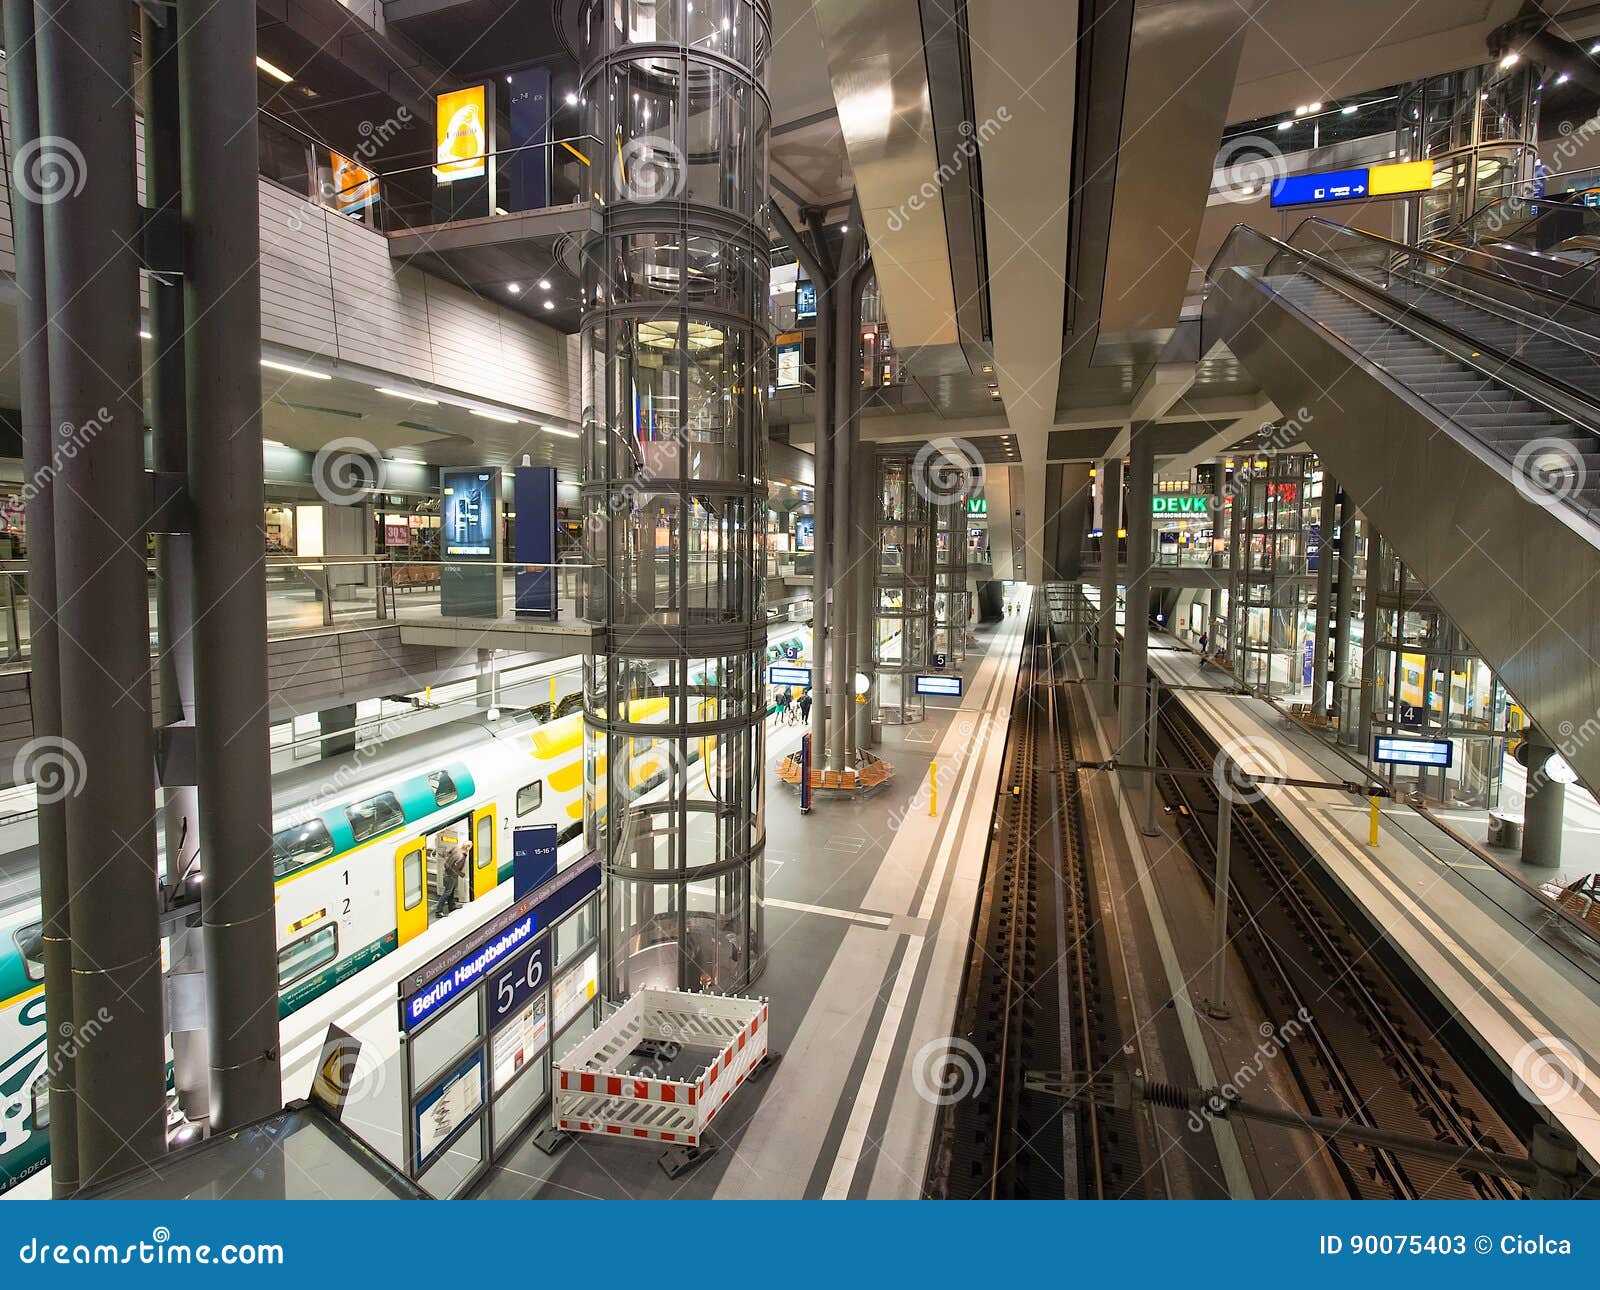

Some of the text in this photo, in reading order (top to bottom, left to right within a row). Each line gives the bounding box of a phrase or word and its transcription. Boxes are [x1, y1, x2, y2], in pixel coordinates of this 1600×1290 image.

[1153, 498, 1207, 512] DEVK
[388, 527, 398, 537] 30
[787, 649, 793, 657] 6
[937, 655, 944, 664] 5
[1404, 707, 1415, 720] 4
[503, 817, 509, 830] 2
[342, 870, 349, 885] 1
[342, 898, 351, 915] 2
[412, 917, 532, 1018] Berlin Hauptbahnhof
[497, 949, 543, 1015] 5-6
[9, 1158, 48, 1187] D-ODEG
